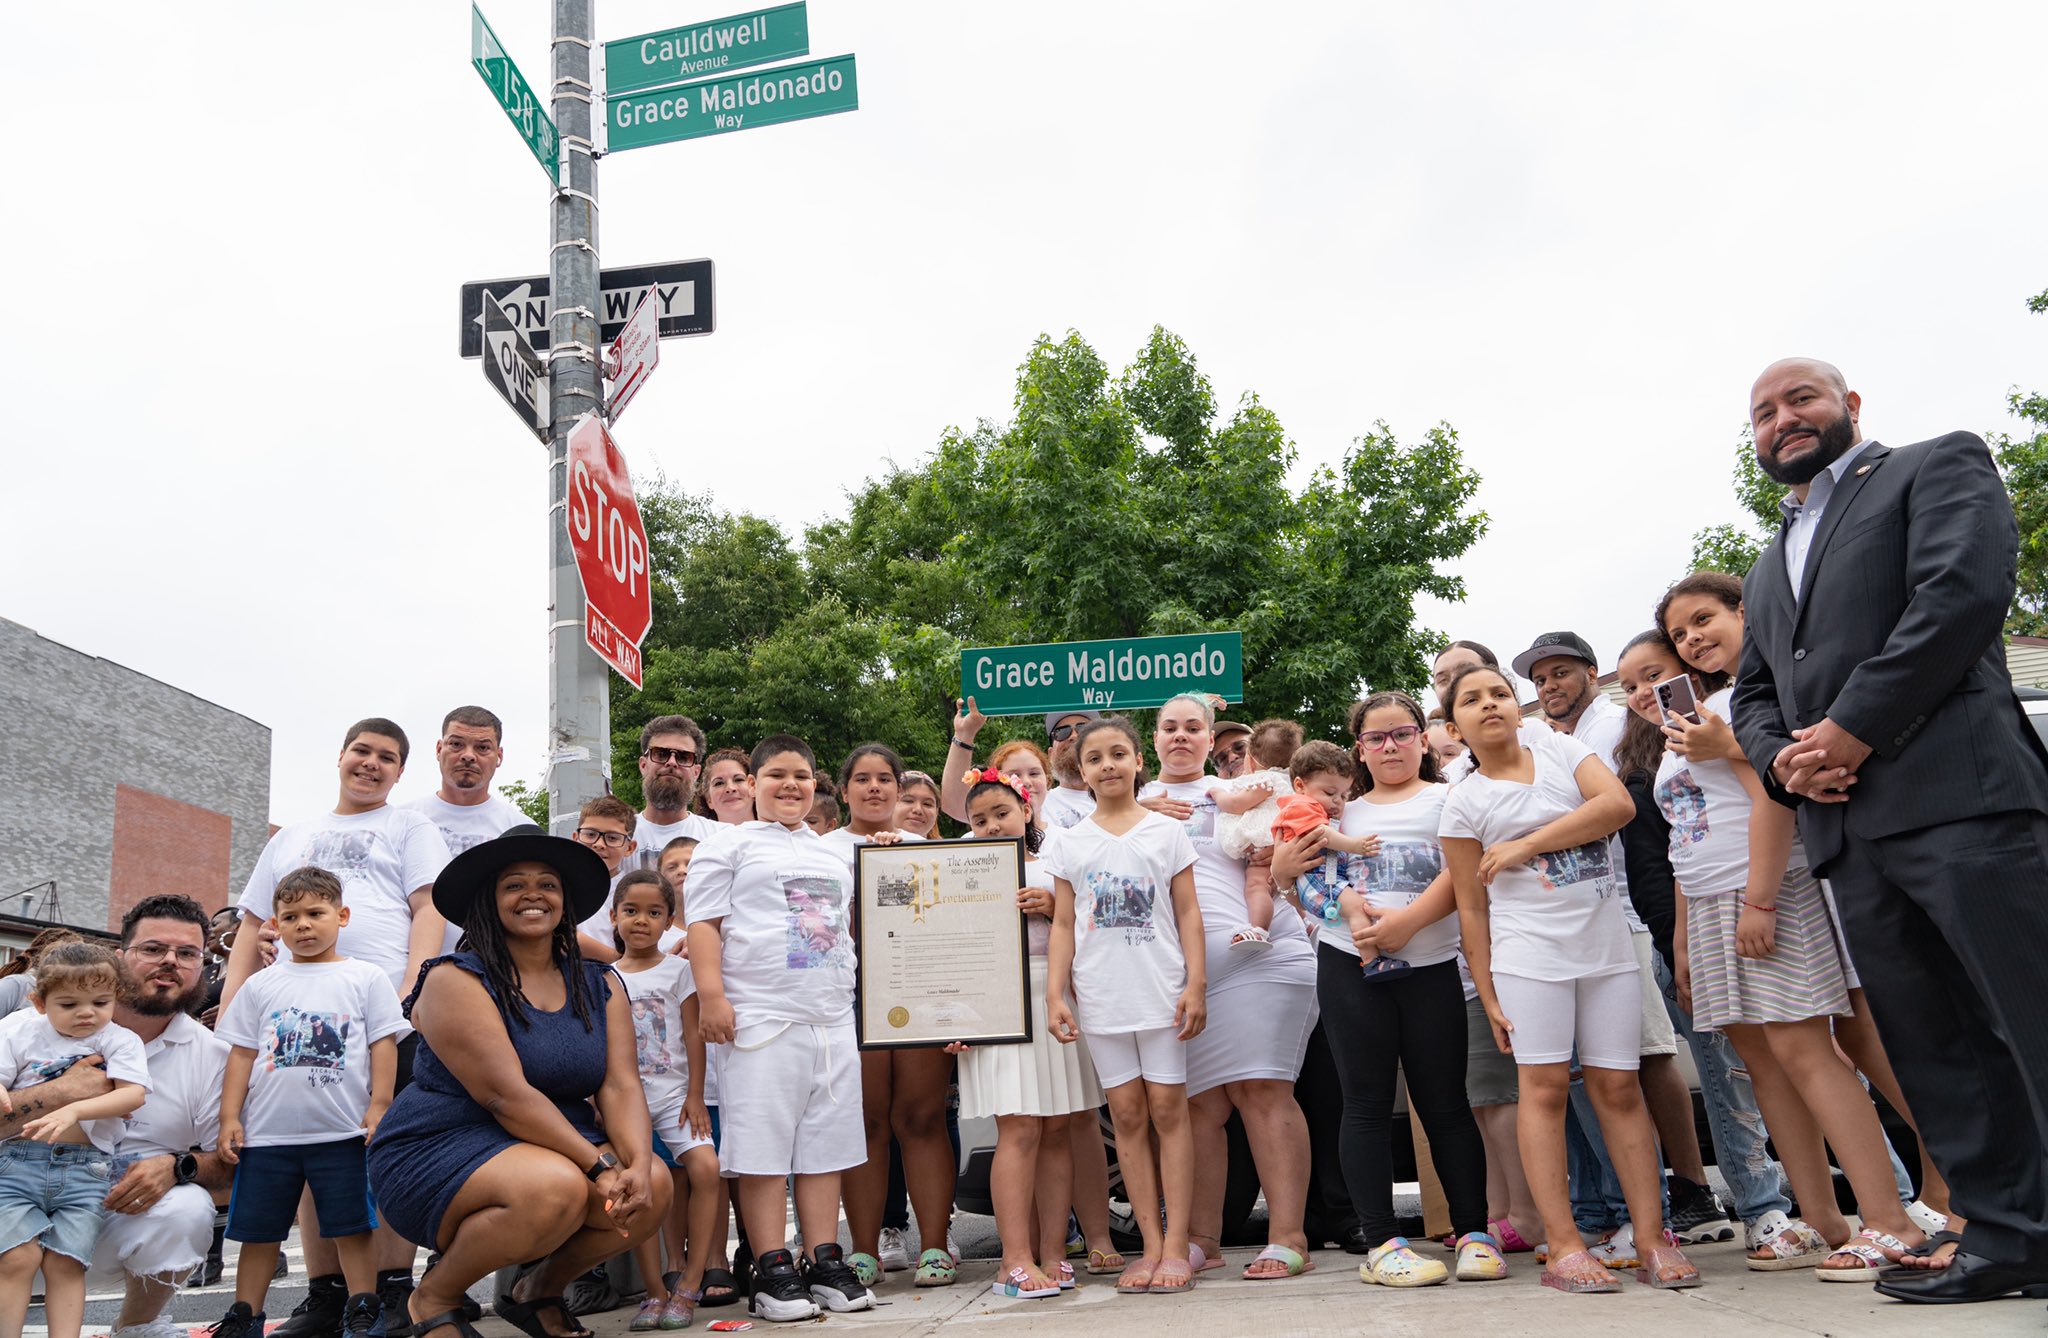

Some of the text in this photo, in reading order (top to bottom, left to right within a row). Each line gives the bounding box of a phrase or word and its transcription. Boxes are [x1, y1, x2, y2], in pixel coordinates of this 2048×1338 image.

[640, 16, 767, 65] Cauldwell
[680, 53, 728, 75] Avenue
[481, 25, 492, 79] E
[503, 59, 534, 139] 158
[616, 69, 843, 129] Grace Maldonado
[714, 113, 743, 131] Way
[503, 300, 546, 329] ON
[501, 341, 535, 405] ONE
[573, 459, 644, 598] STOP
[591, 621, 637, 675] ALL WAY
[976, 643, 1226, 690] Grace Maldonado
[1082, 687, 1114, 708] Way
[946, 852, 1000, 870] The Assembly
